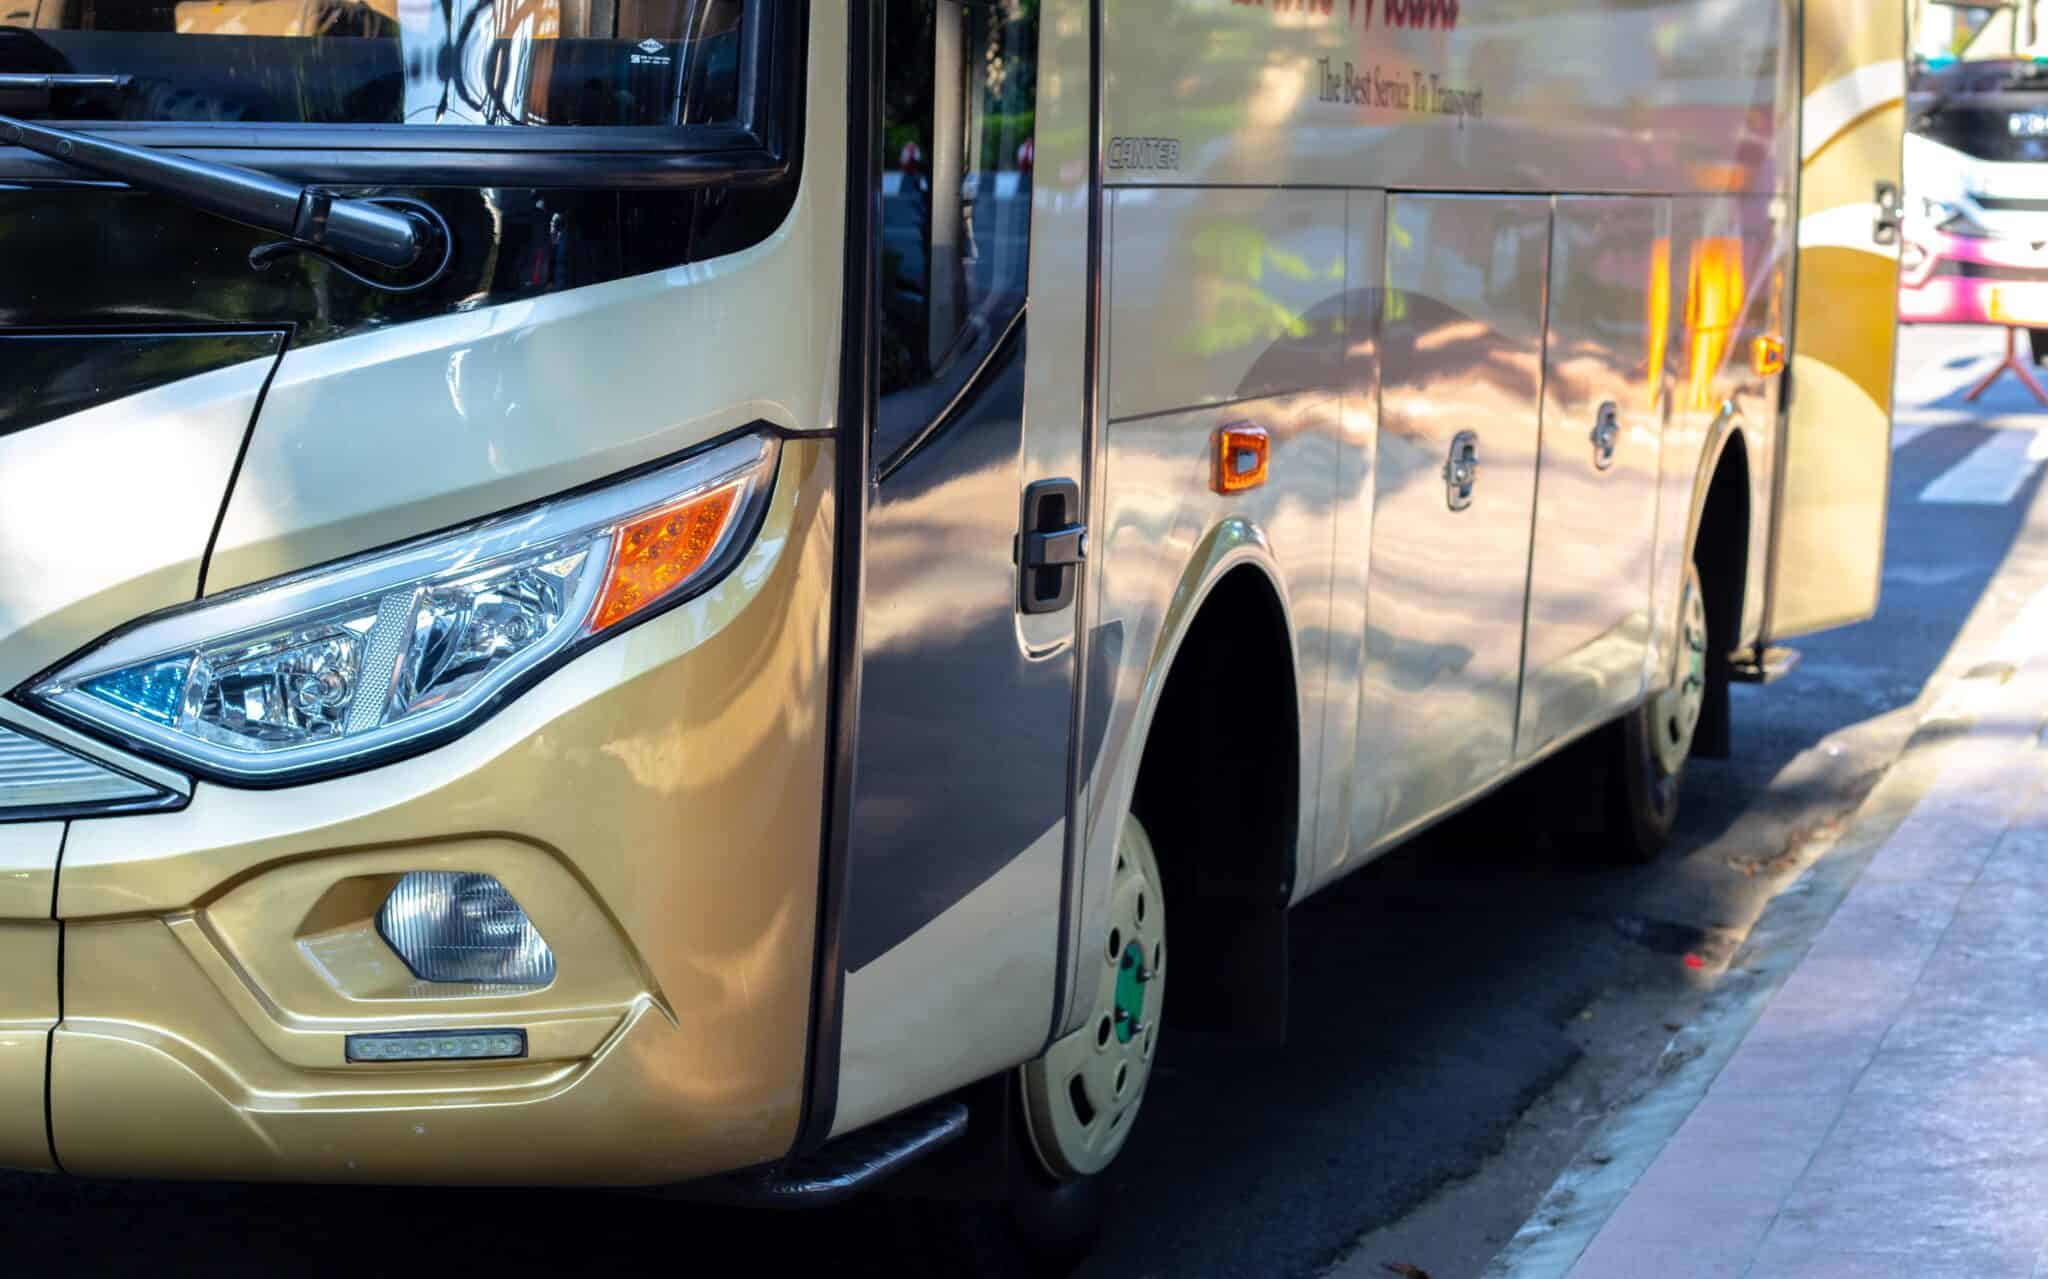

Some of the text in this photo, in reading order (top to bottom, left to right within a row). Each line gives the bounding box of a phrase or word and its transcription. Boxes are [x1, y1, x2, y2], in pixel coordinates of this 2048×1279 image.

[1318, 57, 1342, 102] The
[1344, 61, 1371, 105] Best
[1107, 136, 1180, 170] CANTER
